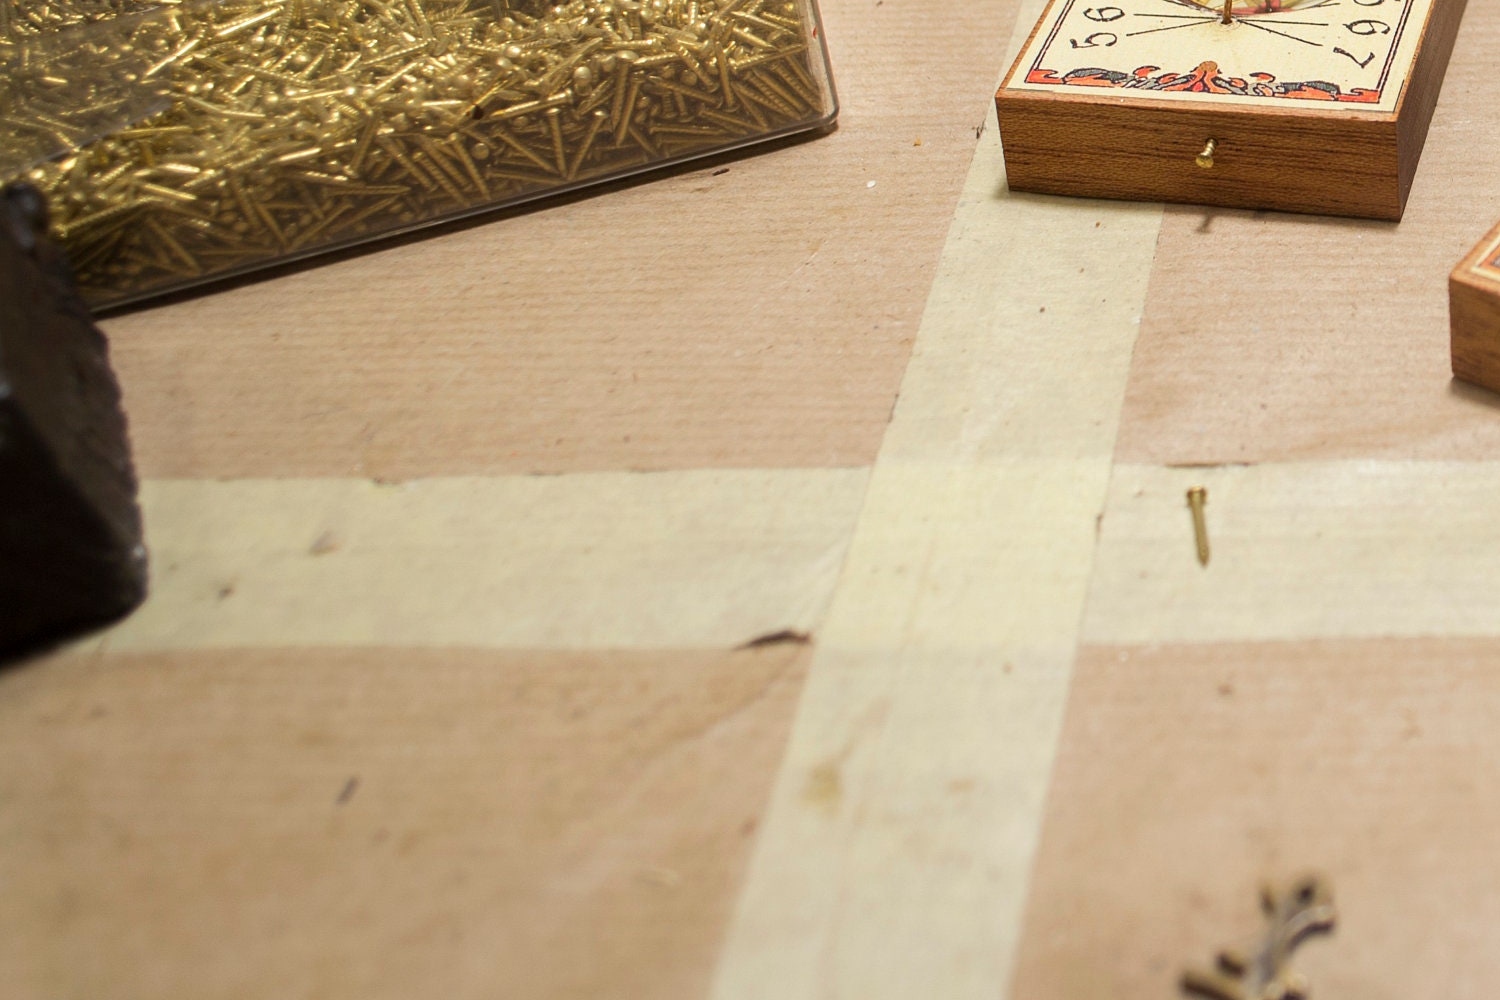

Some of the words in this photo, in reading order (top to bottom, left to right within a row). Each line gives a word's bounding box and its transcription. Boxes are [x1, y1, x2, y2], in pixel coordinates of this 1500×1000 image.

[1083, 6, 1125, 23] 6
[1070, 32, 1118, 49] 5
[1333, 46, 1376, 69] 7
